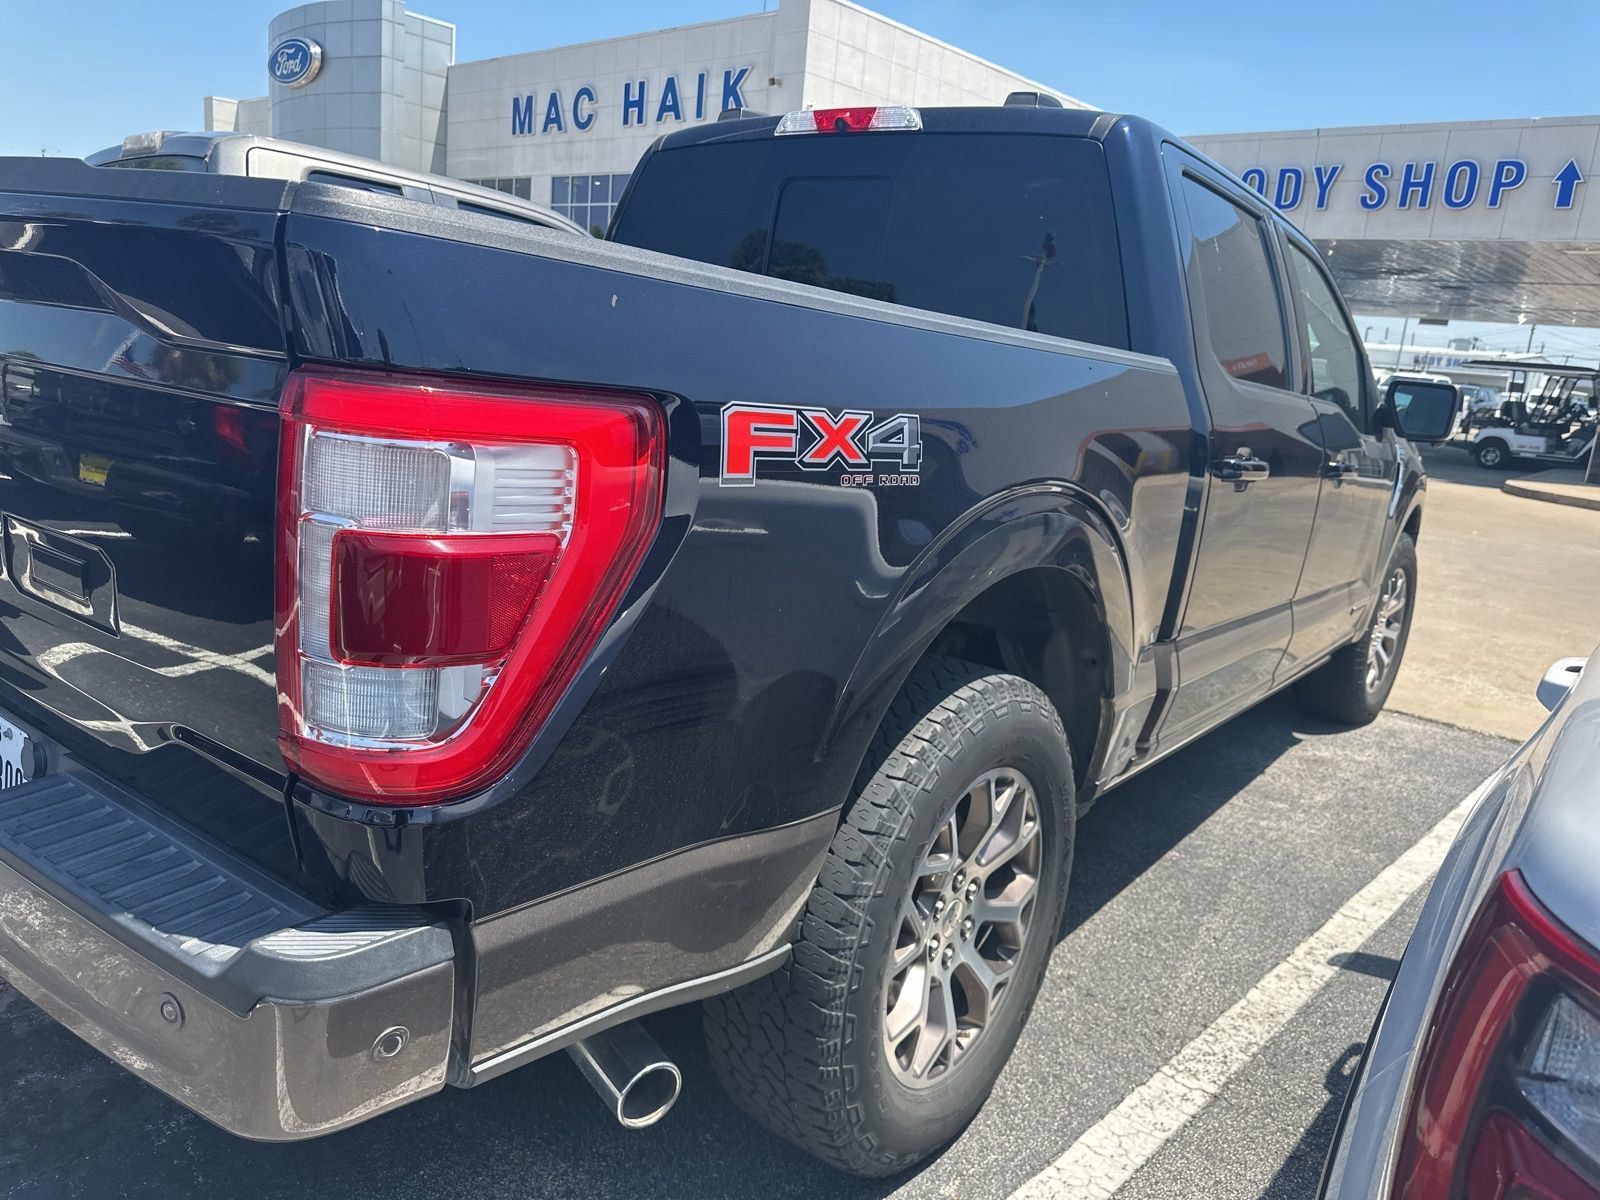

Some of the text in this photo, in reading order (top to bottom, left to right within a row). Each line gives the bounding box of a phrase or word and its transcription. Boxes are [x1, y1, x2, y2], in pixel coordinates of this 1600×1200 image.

[275, 47, 303, 77] Ford
[511, 66, 751, 137] MAC HAIK
[1241, 158, 1528, 211] ODY SHOP
[720, 401, 922, 487] FX4
[840, 474, 921, 486] OFF ROAD
